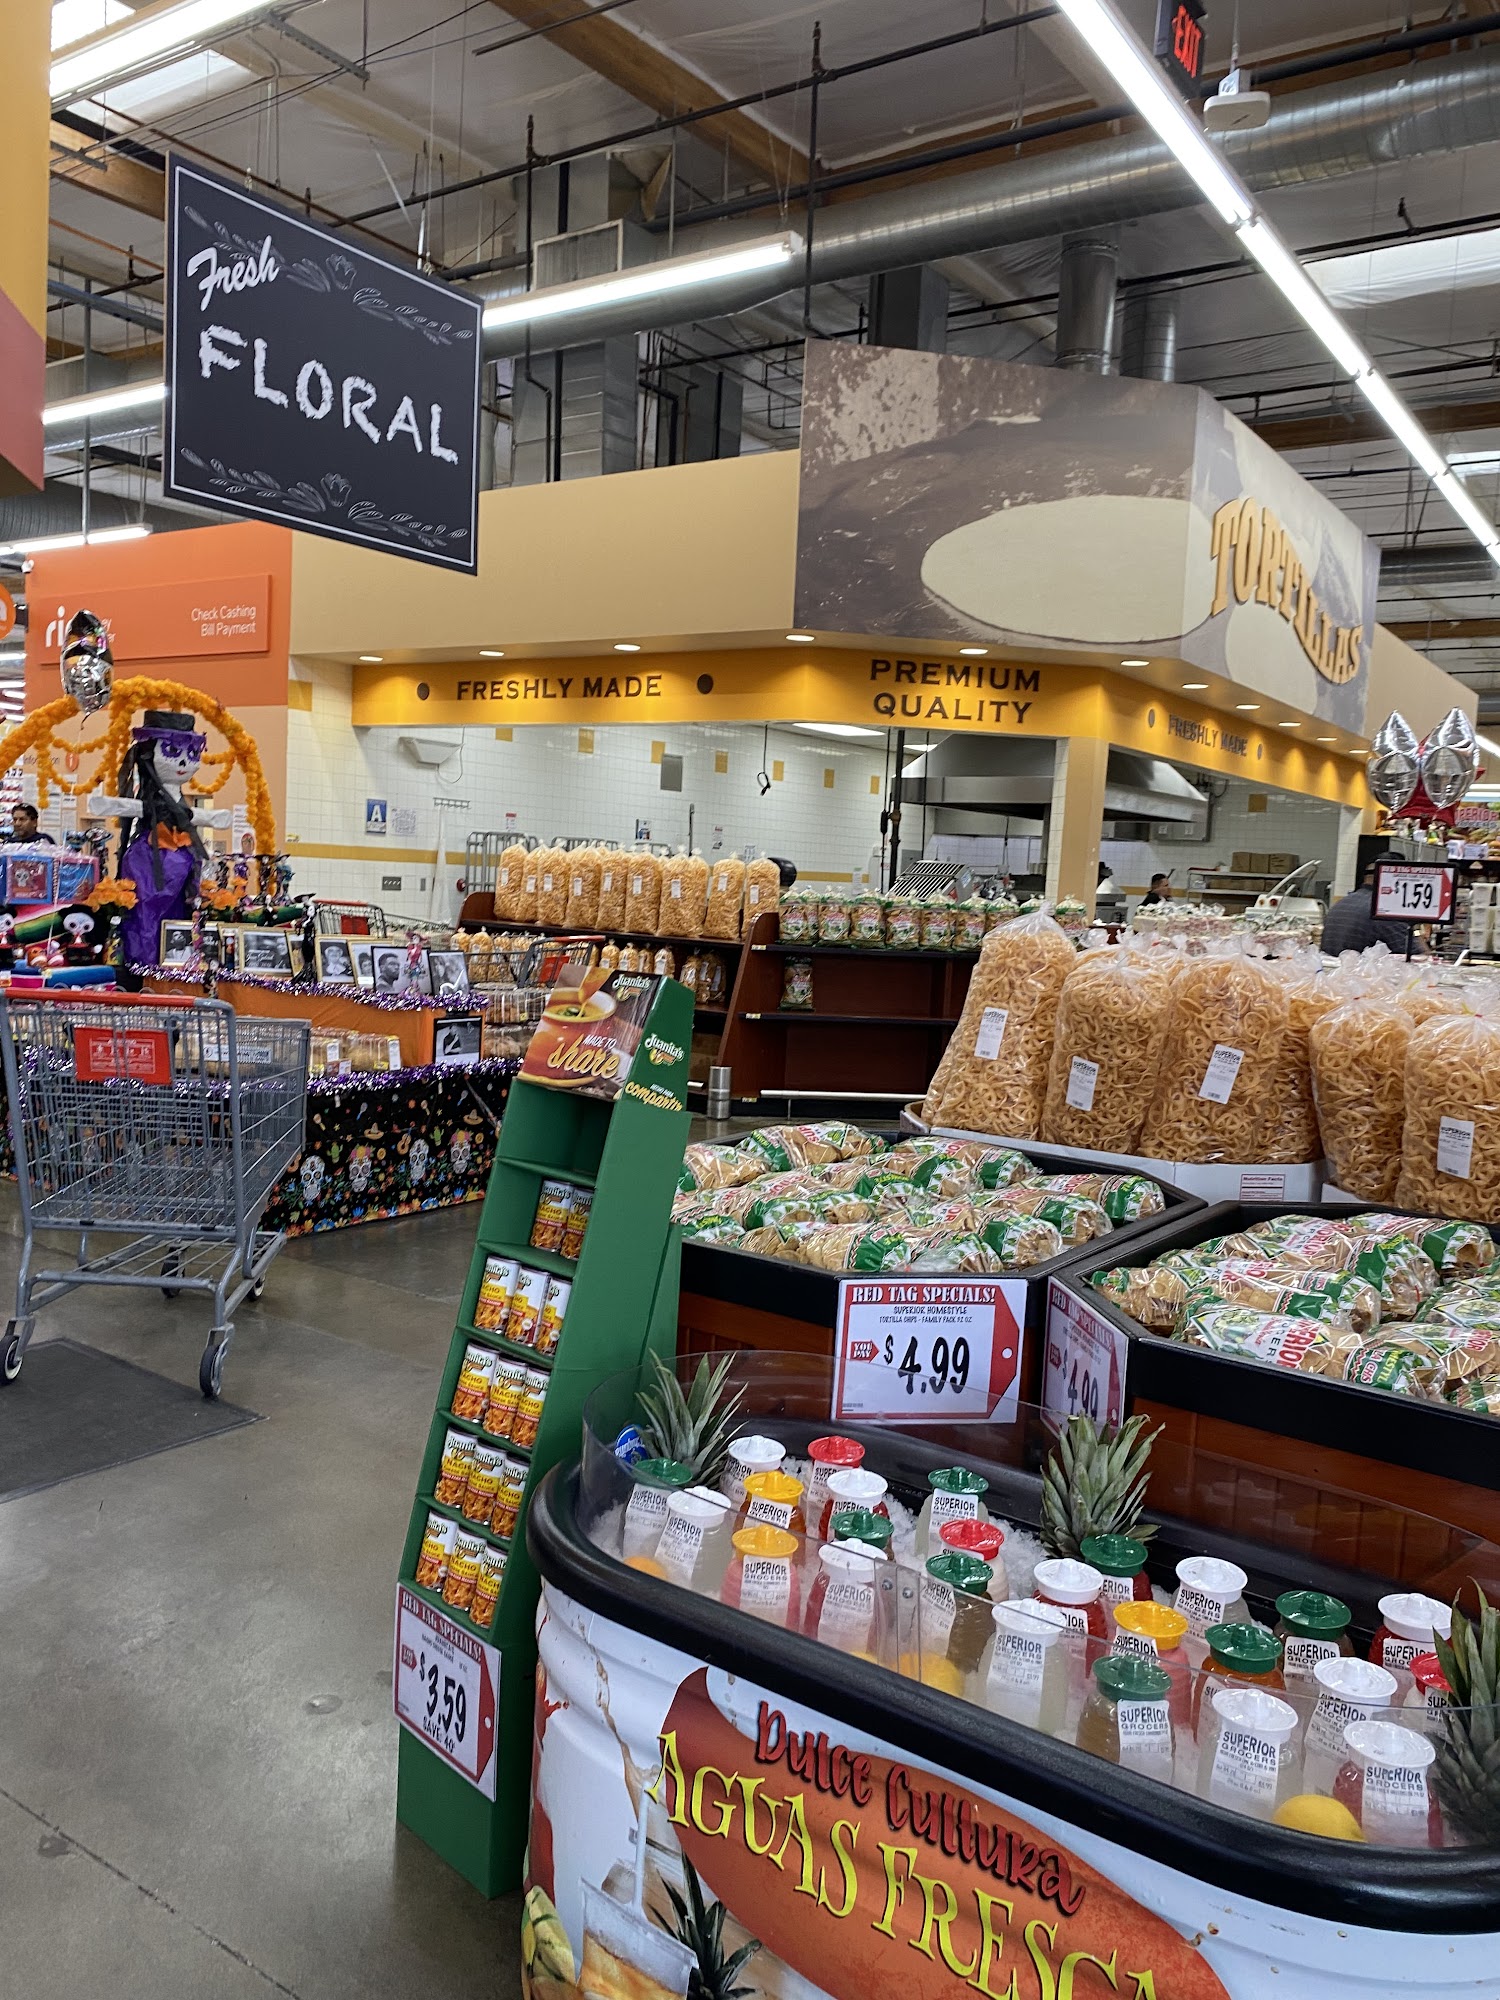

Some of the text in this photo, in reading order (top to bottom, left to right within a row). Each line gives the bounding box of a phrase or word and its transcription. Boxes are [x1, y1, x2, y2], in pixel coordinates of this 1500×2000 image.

[1174, 4, 1201, 78] EXIT
[187, 235, 279, 311] Fresh
[199, 324, 459, 465] FLORAL
[1210, 496, 1363, 685] TORTILLAS
[191, 604, 256, 621] Check Cashing
[201, 622, 256, 638] Bill Payment
[870, 658, 1041, 692] PREMIUM
[457, 674, 662, 700] FRESHLY MADE
[873, 692, 1033, 724] QUALITY
[1167, 713, 1248, 757] FRESHLY MADE
[611, 973, 651, 989] Juanita's
[583, 1034, 617, 1050] MADE TO
[645, 1033, 685, 1061] Juanita's
[547, 1033, 620, 1079] share
[852, 1286, 996, 1303] RED TAG SPECIALS!
[894, 1306, 968, 1315] SUPERIOR HOMESTYLE
[633, 1490, 667, 1506] SUPERIOR
[935, 1496, 975, 1511] SUPERIOR
[751, 1501, 788, 1520] SUPERIOR
[744, 1561, 787, 1575] SUPERIOR
[744, 1573, 787, 1581] GROCERS
[403, 1590, 419, 1611] RED
[421, 1602, 438, 1626] TAG
[1178, 1597, 1220, 1619] GROCERS
[1180, 1588, 1221, 1613] SUPERIOR
[997, 1634, 1042, 1653] SUPERIOR
[1287, 1643, 1336, 1659] SUPERIOR
[1287, 1655, 1316, 1665] GROC
[1120, 1706, 1167, 1723] SUPERIOR
[1121, 1722, 1168, 1730] GROCERS
[753, 1700, 873, 1806] Dulce
[1221, 1742, 1276, 1766] GROCERS
[1223, 1731, 1276, 1758] SUPERIOR
[1366, 1766, 1422, 1784] SUPERIOR
[1366, 1778, 1424, 1791] GROCERS
[645, 1730, 861, 1918] AGUAS
